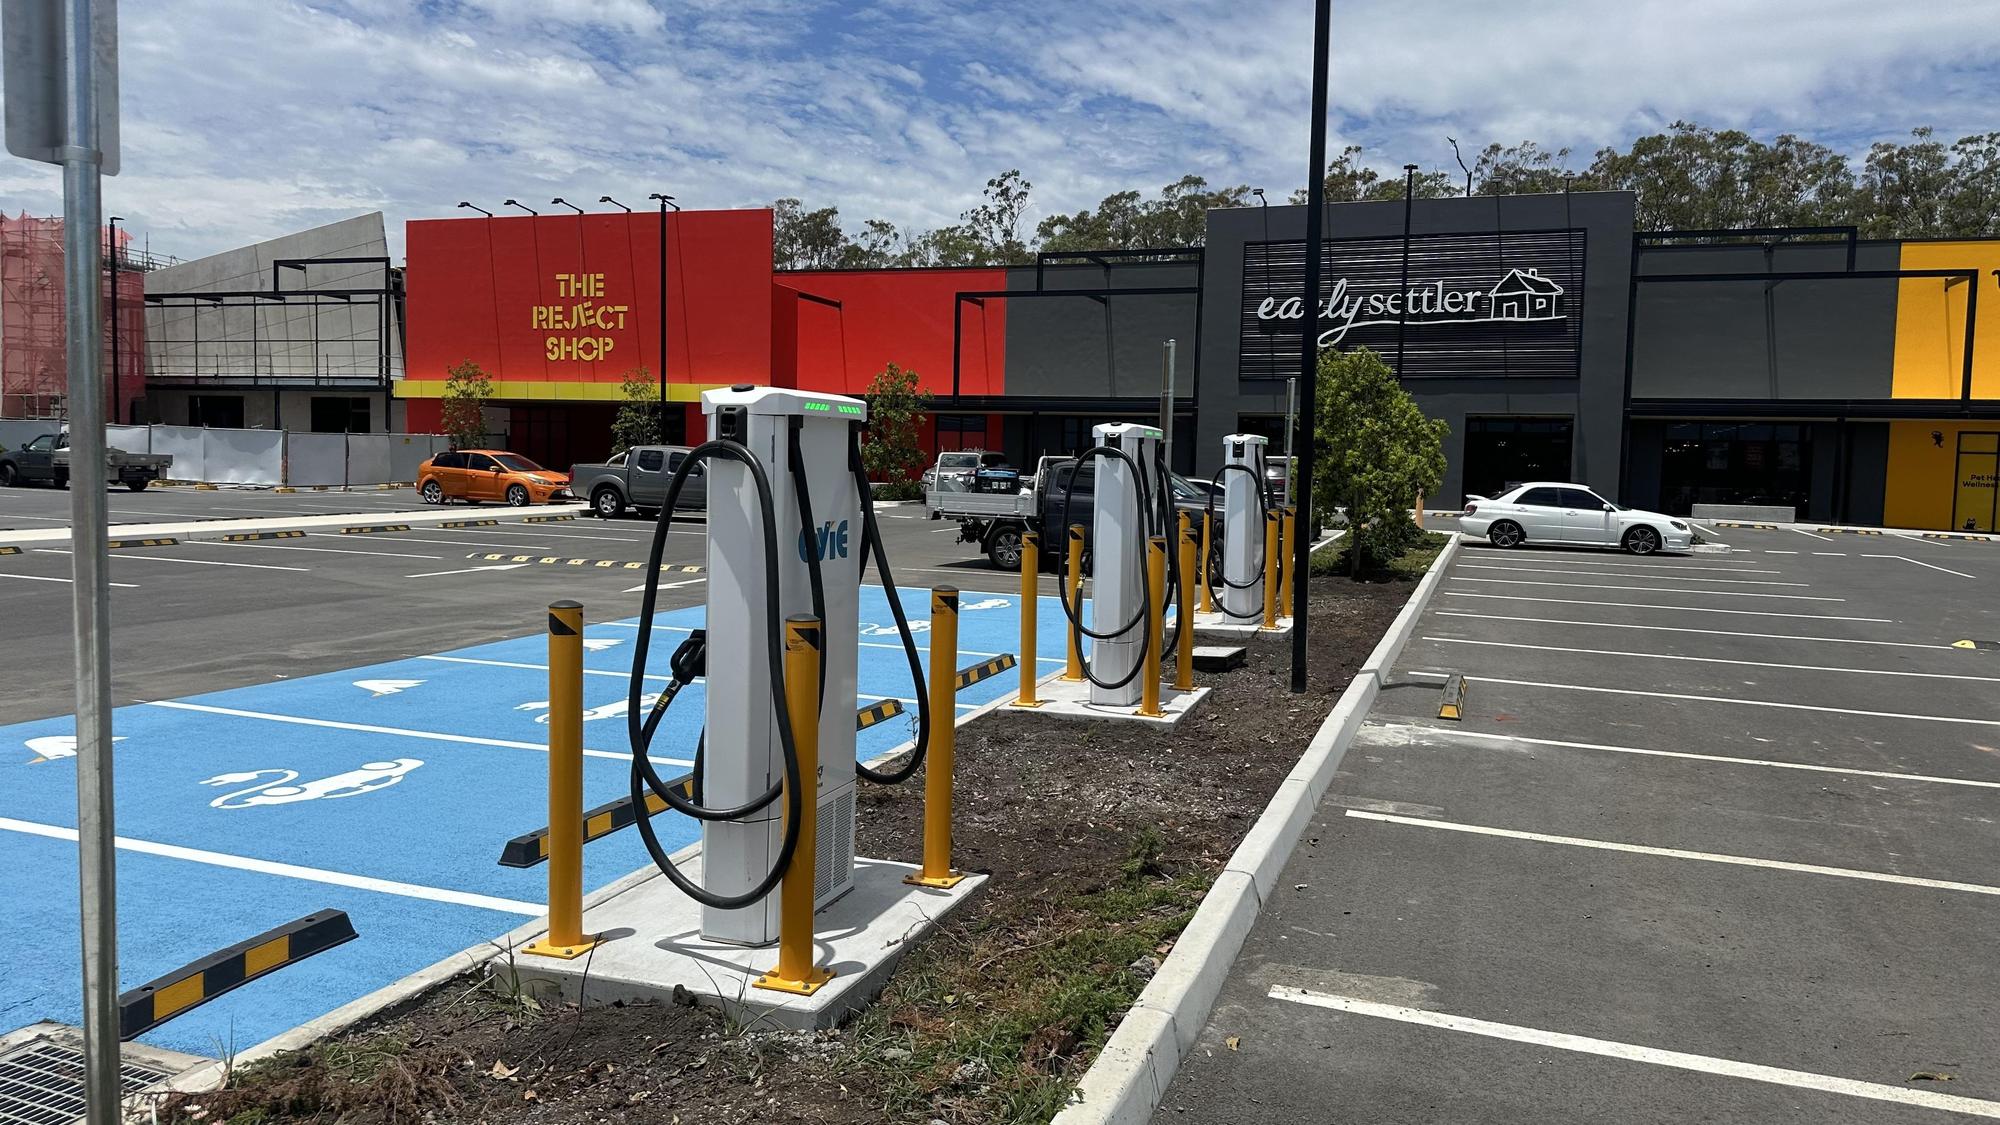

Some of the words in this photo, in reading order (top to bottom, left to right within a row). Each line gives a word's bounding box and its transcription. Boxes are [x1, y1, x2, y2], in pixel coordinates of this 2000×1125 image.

[556, 274, 604, 297] THE
[533, 301, 628, 330] REJECT
[1258, 278, 1363, 347] ealy
[1369, 280, 1482, 314] settler
[546, 337, 614, 361] SHOP
